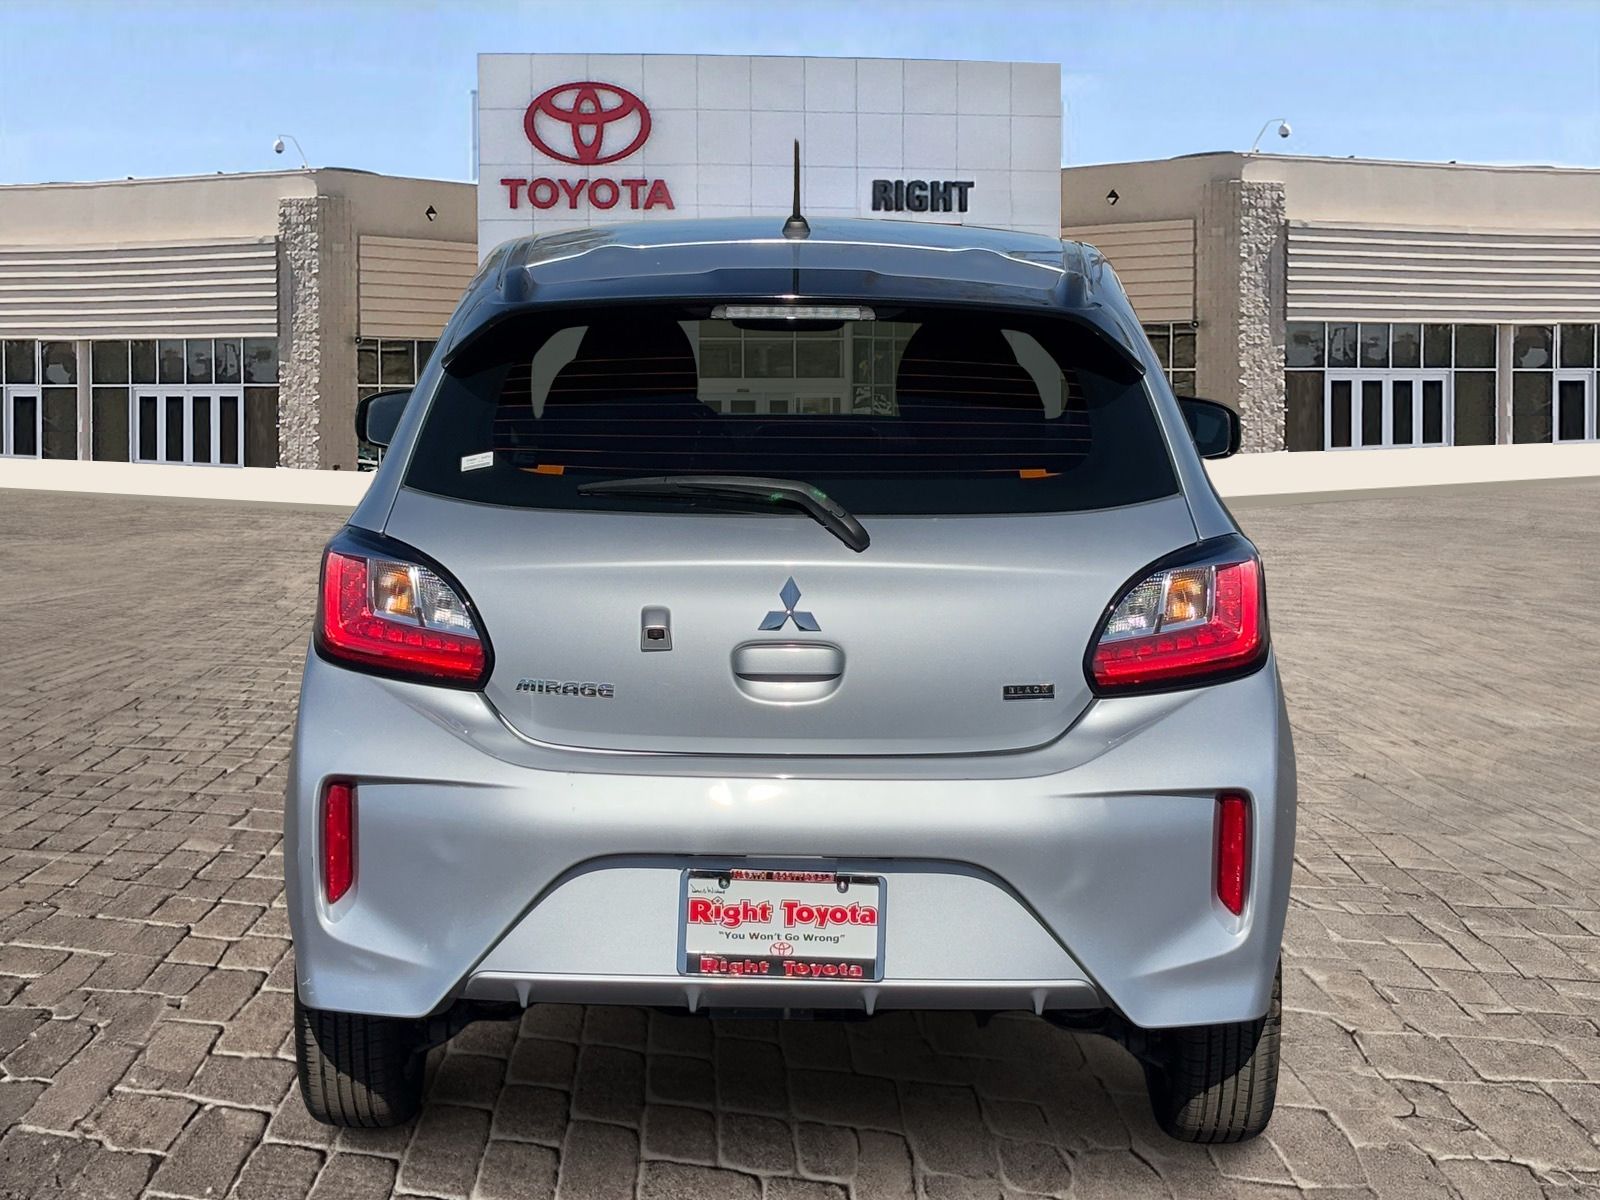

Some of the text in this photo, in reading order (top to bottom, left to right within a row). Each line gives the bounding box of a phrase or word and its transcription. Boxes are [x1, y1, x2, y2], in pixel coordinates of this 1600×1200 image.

[500, 178, 676, 210] TOYOTA
[871, 179, 975, 213] RIGHT
[515, 678, 614, 699] MIRAGE
[1008, 685, 1049, 695] BLACK
[688, 897, 879, 930] Right Toyota
[719, 930, 846, 944] "You Won't Go Wrong"
[700, 957, 863, 977] Right Toyota
